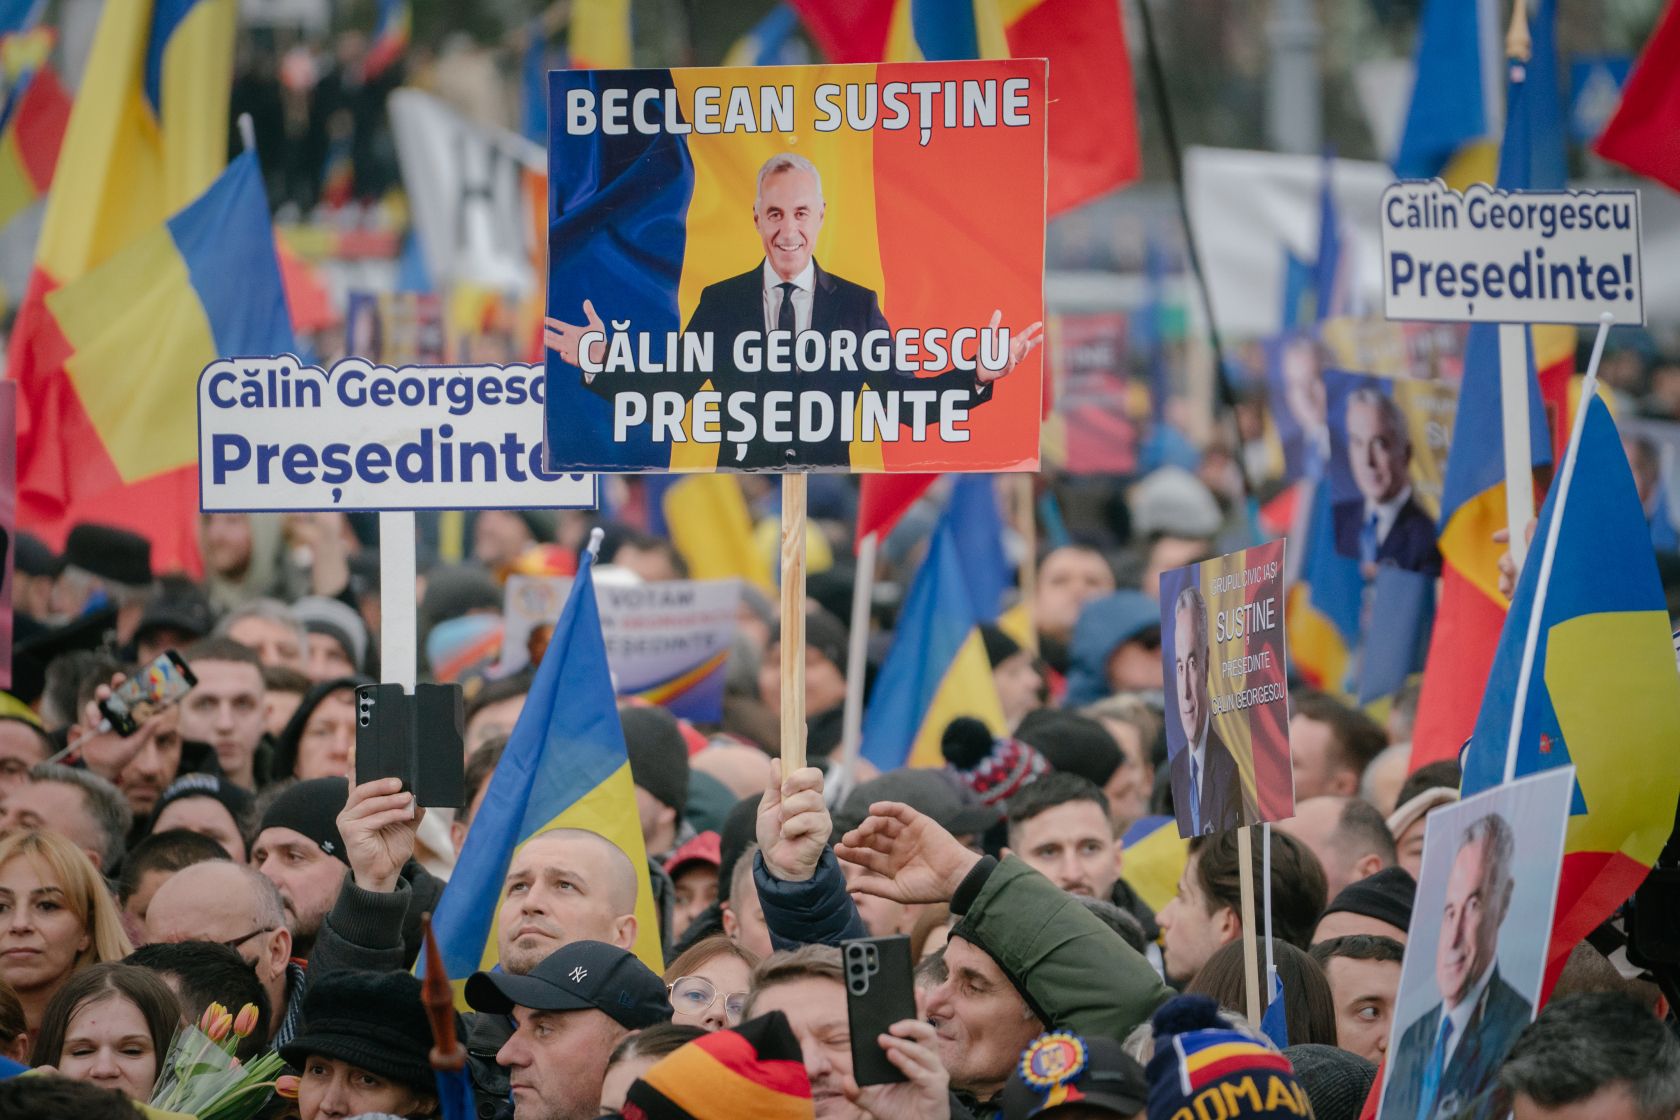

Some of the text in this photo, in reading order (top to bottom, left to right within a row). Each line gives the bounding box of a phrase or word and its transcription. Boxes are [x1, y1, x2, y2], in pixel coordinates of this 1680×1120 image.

[566, 78, 1031, 147] BECLEAN SUSȚINE
[1387, 192, 1631, 238] Călin Georgescu
[1390, 246, 1634, 315] Președinte!
[578, 320, 715, 374] CĂLIN
[733, 327, 1011, 373] GEORGESCU
[208, 366, 544, 416] Călin Georgesc
[614, 389, 971, 462] PREȘEDINTE
[1211, 573, 1242, 596] GRUPUL
[1243, 566, 1263, 589] CIVIC
[1216, 597, 1276, 645] SUSȚINE
[1235, 682, 1285, 709] GEORGESCU
